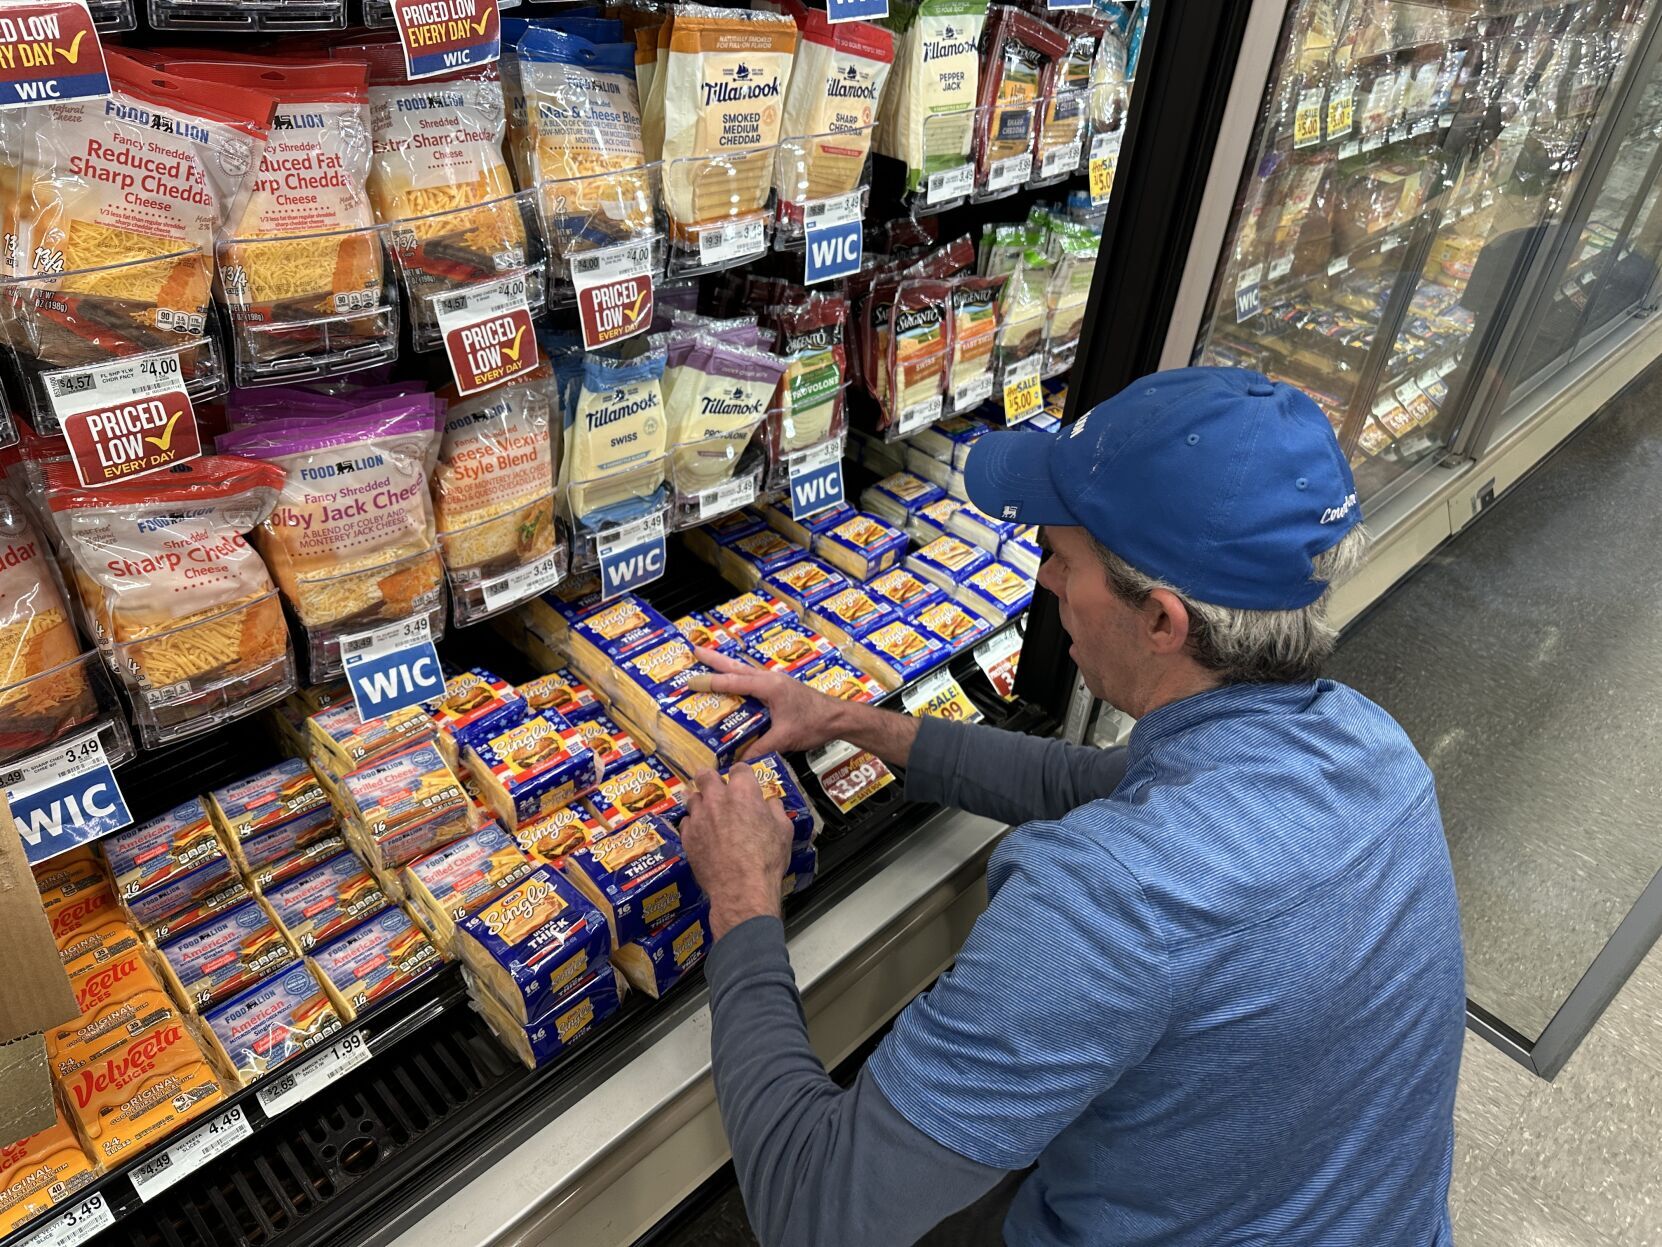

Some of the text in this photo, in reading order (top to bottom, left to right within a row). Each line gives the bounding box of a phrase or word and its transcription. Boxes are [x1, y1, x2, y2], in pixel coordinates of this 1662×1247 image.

[401, 0, 477, 26] PRICED LOW
[23, 14, 60, 40] LOW
[408, 18, 472, 47] EVERY DAY
[18, 42, 55, 67] DAY
[443, 49, 471, 66] WIC
[923, 36, 978, 62] Tillamook
[602, 82, 621, 95] LION
[940, 71, 965, 82] PEPPER
[942, 82, 961, 92] JACK
[14, 80, 60, 100] WIC
[701, 77, 781, 106] Tillamook
[105, 100, 209, 144] FOOD LION
[294, 114, 324, 128] LION
[420, 117, 459, 129] Shredded
[571, 106, 581, 118] &
[722, 112, 760, 124] SMOKED
[835, 113, 858, 124] SHARP
[113, 133, 144, 149] Fancy
[413, 133, 453, 149] Sharp
[719, 134, 761, 146] CHEDDAR
[723, 124, 759, 134] MEDIUM
[87, 139, 179, 179] Reduced
[279, 142, 321, 153] Shredded
[69, 156, 134, 190] Sharp
[124, 192, 171, 211] Cheese
[276, 194, 317, 206] Cheese
[132, 222, 153, 231] cheddar
[154, 226, 171, 234] cheese
[812, 233, 858, 269] WIC
[592, 281, 637, 310] PRICED
[1239, 289, 1260, 312] WIC
[161, 311, 170, 320] 90
[596, 306, 622, 332] LOW
[461, 317, 516, 352] PRICED
[599, 322, 639, 341] EVERY DAY
[468, 344, 502, 374] LOW
[60, 375, 91, 391] $4.57
[474, 360, 522, 384] EVERY DAY
[792, 376, 839, 400] PROVOLONE
[586, 391, 659, 431] Tillamook
[702, 396, 762, 415] Tillamook
[86, 401, 168, 441] PRICED
[96, 433, 144, 467] LOW
[455, 436, 478, 448] Fancy
[610, 432, 638, 448] SWISS
[824, 442, 839, 456] 3.99
[104, 450, 176, 478] EVERY DAY
[300, 454, 384, 480] FOOD LION
[454, 447, 538, 480] Style Blend
[304, 477, 391, 505] Fancy Shredded
[795, 472, 839, 507] WIC
[302, 508, 405, 539] A BLEND OF COLBY AND
[321, 498, 367, 524] Jack
[643, 515, 662, 531] 3.49
[299, 531, 352, 549] MONTEREY
[353, 526, 374, 541] JACK
[107, 551, 182, 578] Sharp
[185, 564, 229, 579] Cheese
[533, 560, 553, 577] 3.49
[607, 547, 660, 586] WIC
[403, 618, 428, 637] 3.49
[588, 601, 642, 634] Singles
[924, 604, 962, 631] Singles
[622, 627, 651, 645] THICK
[760, 630, 805, 660] Singles
[875, 624, 914, 651] Singles
[636, 642, 689, 676] Singles
[358, 657, 437, 704] WIC
[666, 706, 679, 716] 16
[929, 685, 960, 712] SALE!
[720, 710, 750, 732] THICK
[65, 740, 99, 763] 3.49
[352, 746, 365, 758] 16
[493, 720, 558, 760] Singles
[350, 767, 421, 796] Grilled Cheese
[356, 761, 404, 782] FOOD LION
[601, 764, 663, 803] Singles
[14, 783, 117, 846] WIC
[117, 823, 171, 852] American
[372, 821, 386, 834] 16
[517, 809, 582, 851] Singles
[590, 821, 658, 862] Singles
[624, 852, 664, 878] THICK
[636, 863, 667, 883] AMERICAN
[124, 881, 140, 895] 16
[484, 880, 557, 935] Singles
[155, 925, 169, 938] 16
[177, 923, 228, 952] FOOD LION
[527, 917, 570, 949] THICK
[532, 920, 555, 937] ULTRA
[182, 930, 236, 961] American
[327, 928, 374, 958] FOOD LION
[333, 935, 384, 966] American
[195, 989, 211, 1004] 16
[225, 990, 276, 1025] FOOD LION
[352, 993, 367, 1008] 16
[77, 1003, 135, 1037] ORIGINAL
[230, 1000, 285, 1037] American
[330, 1035, 361, 1060] 1.99
[58, 1057, 75, 1071] 24
[73, 1025, 182, 1109] Velveeta
[115, 1062, 156, 1090] SLICES
[120, 1075, 179, 1112] ORIGINAL
[268, 1076, 294, 1097] $2.65
[209, 1108, 241, 1135] 4.49
[102, 1137, 120, 1151] 24
[182, 1140, 201, 1153] SLICES
[140, 1154, 171, 1175] $4.49
[52, 1184, 62, 1194] 40
[64, 1196, 102, 1227] 3.49
